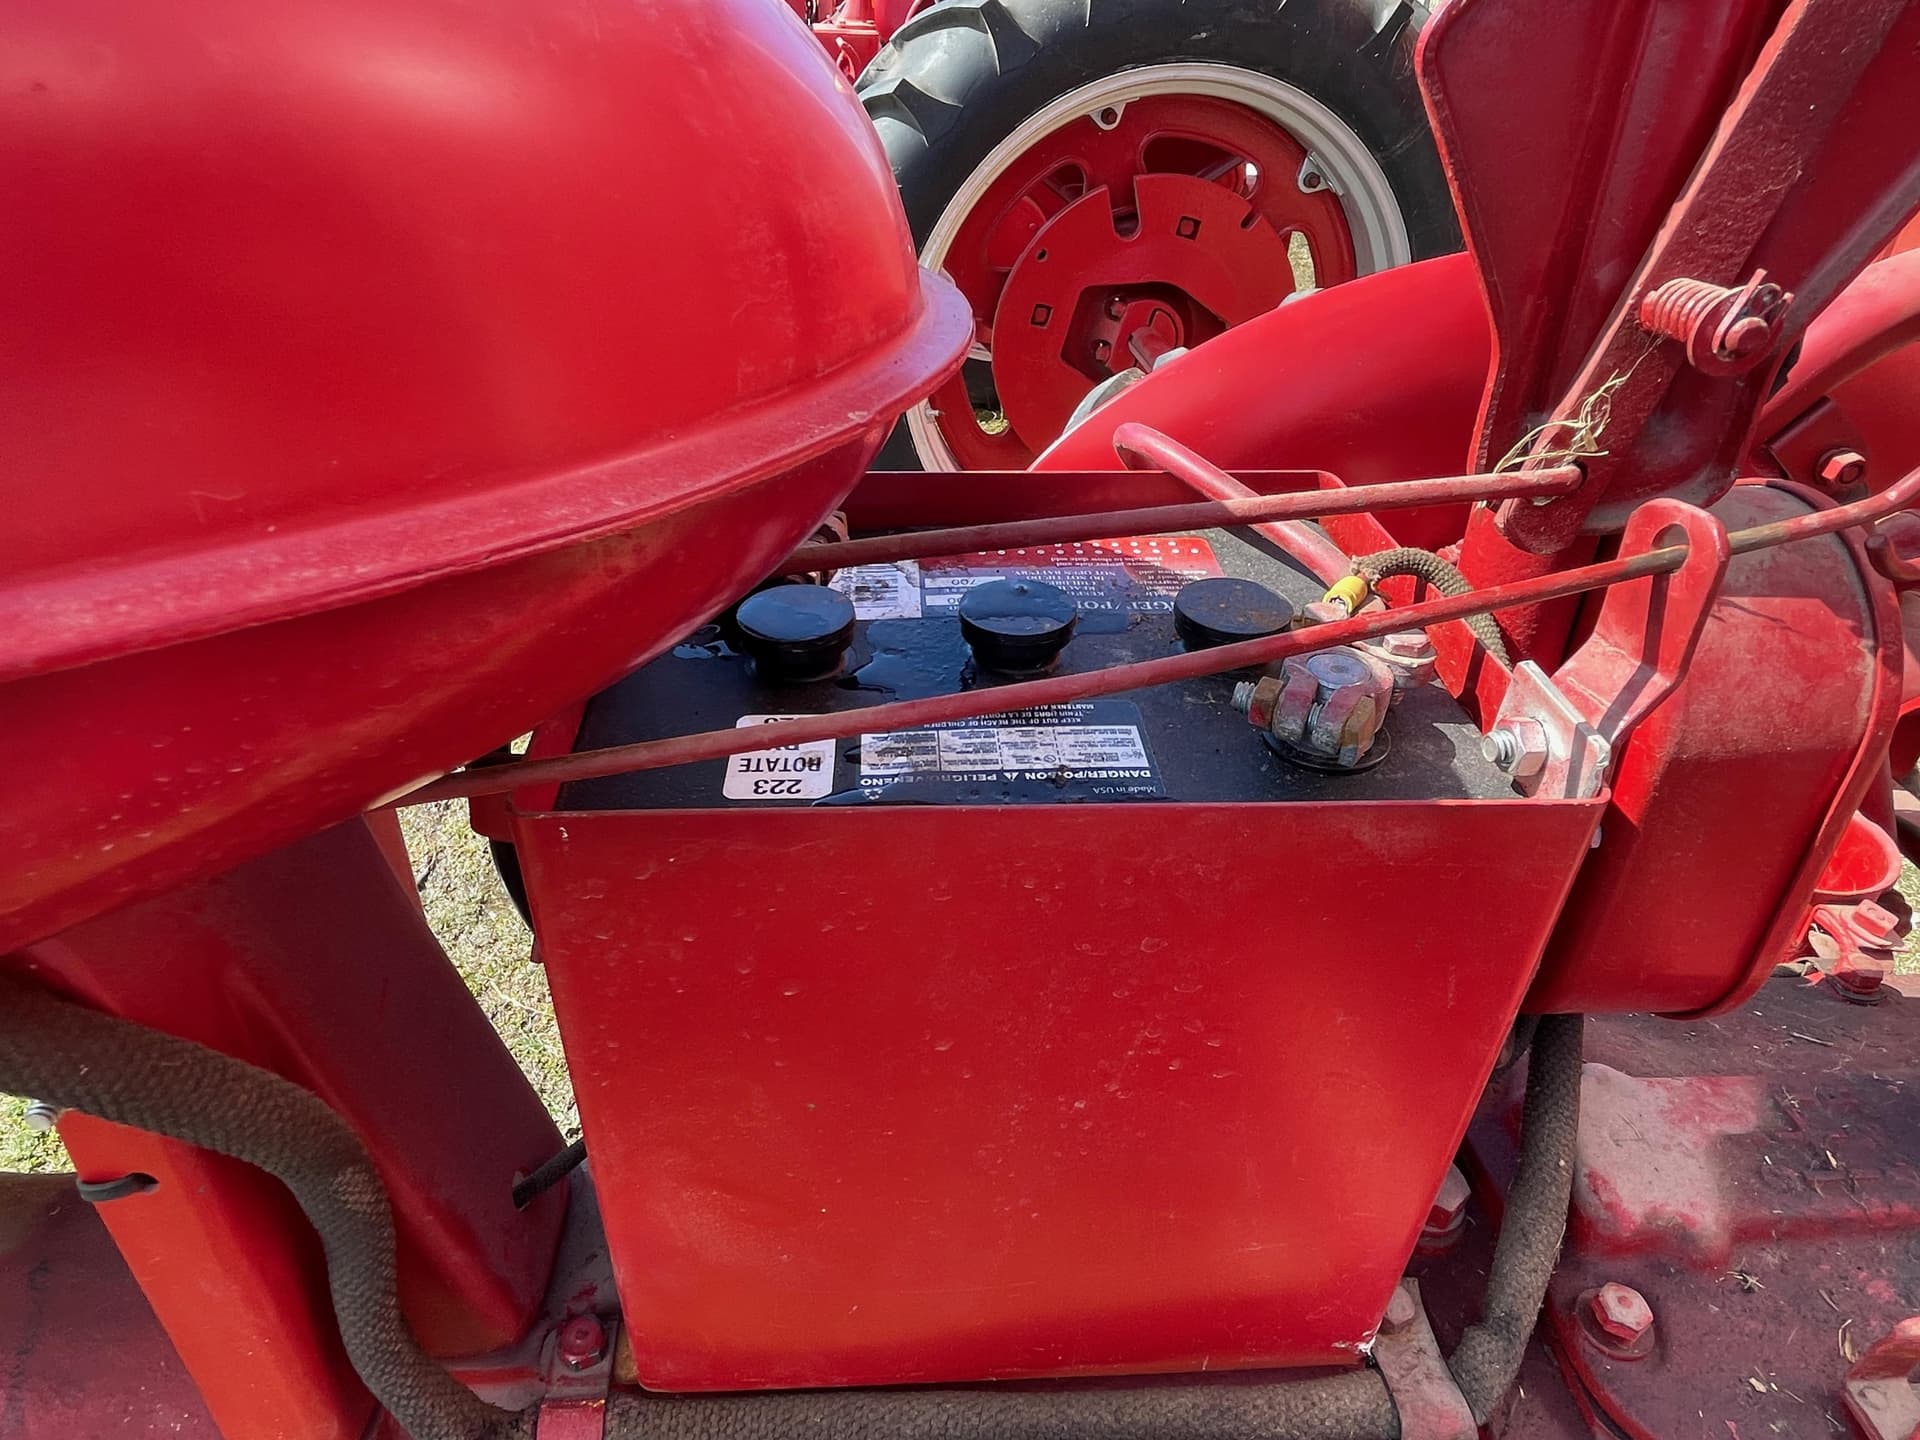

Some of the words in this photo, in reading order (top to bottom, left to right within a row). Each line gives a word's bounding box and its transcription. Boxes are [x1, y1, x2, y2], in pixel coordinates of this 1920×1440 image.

[737, 757, 822, 772] ROTATE
[752, 779, 802, 795] 223
[1092, 786, 1114, 795] USA
[1115, 786, 1126, 794] in
[1128, 786, 1157, 795] Made
